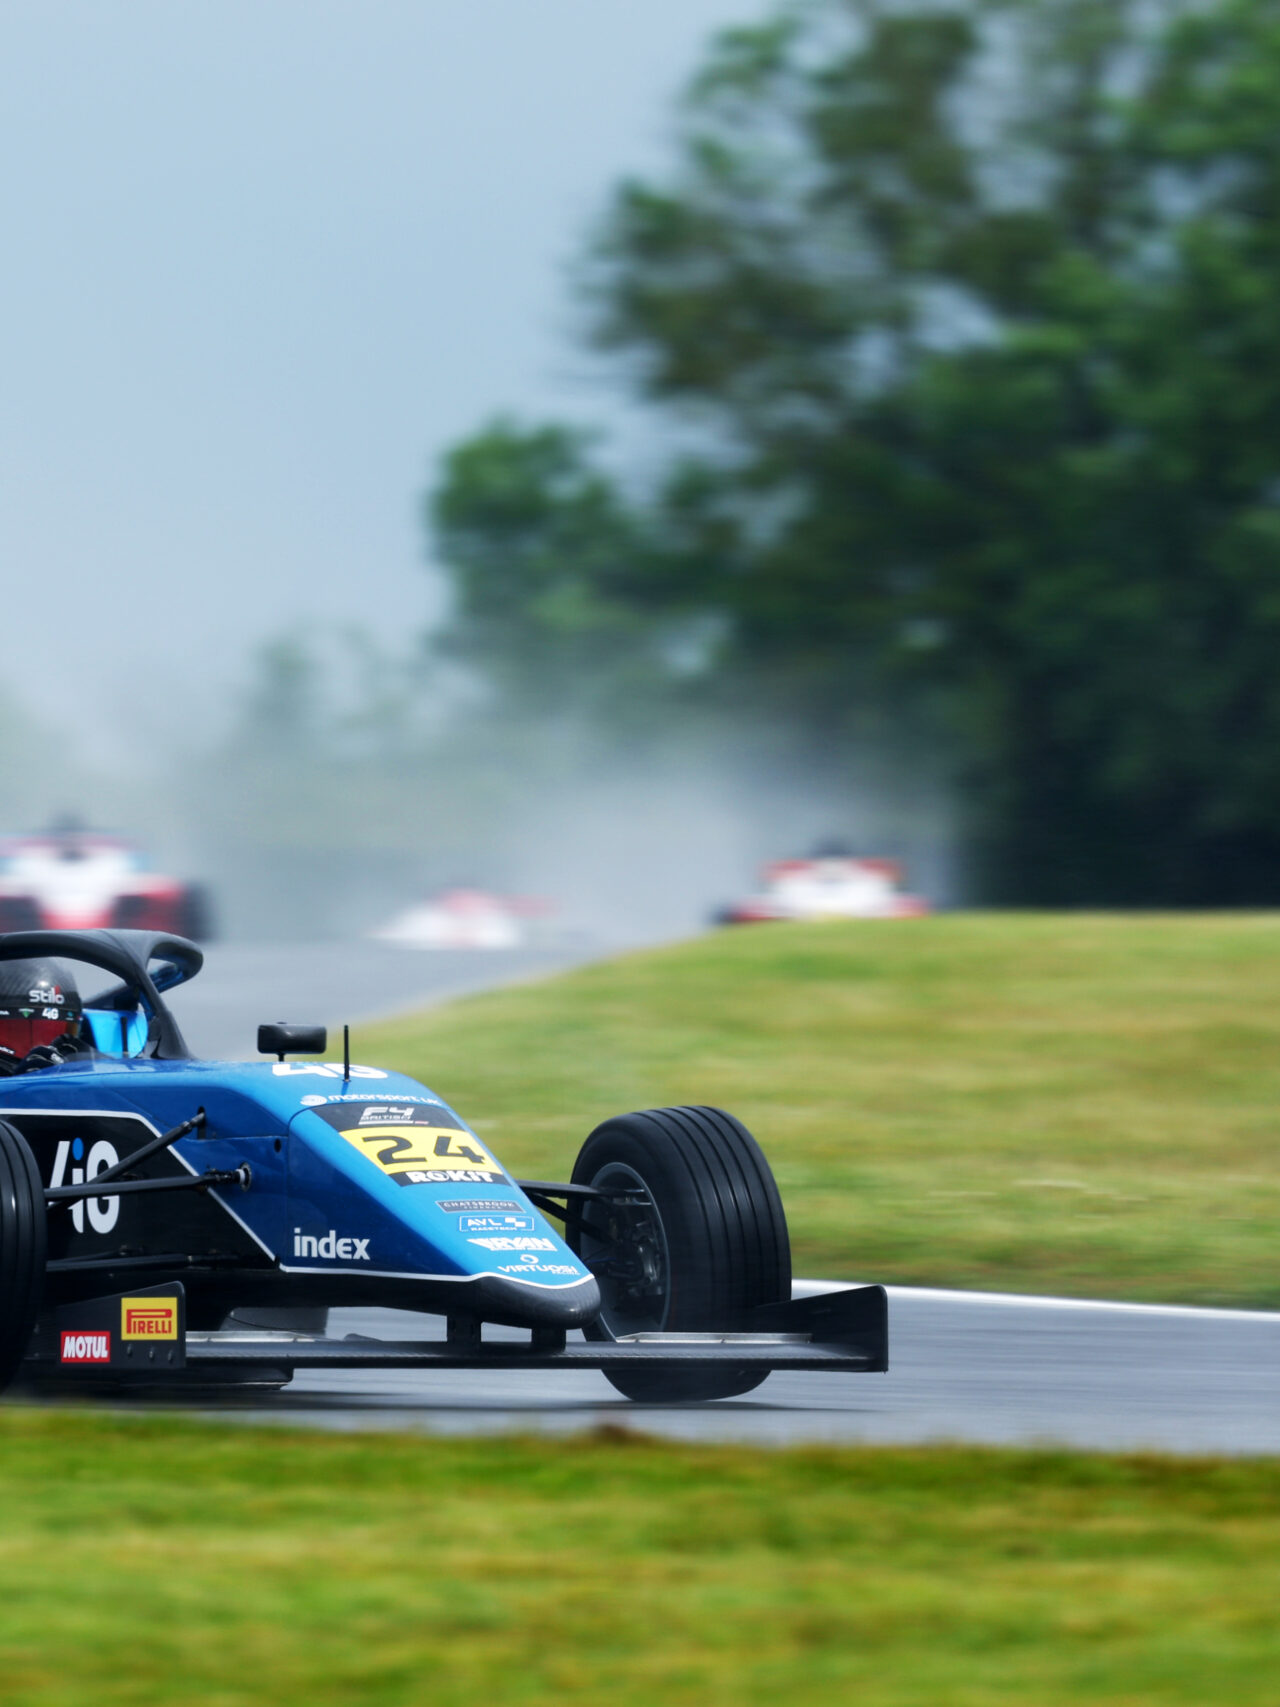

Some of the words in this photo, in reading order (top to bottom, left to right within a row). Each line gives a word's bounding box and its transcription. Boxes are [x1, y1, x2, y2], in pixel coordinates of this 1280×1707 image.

[29, 985, 64, 1005] Stilo
[361, 1107, 415, 1119] F4
[362, 1135, 486, 1165] 24
[468, 1218, 502, 1226] AVL
[294, 1227, 371, 1260] index
[498, 1264, 578, 1274] VIRTUOSI
[126, 1308, 173, 1335] PIRELLI
[63, 1336, 109, 1358] MOTUL
